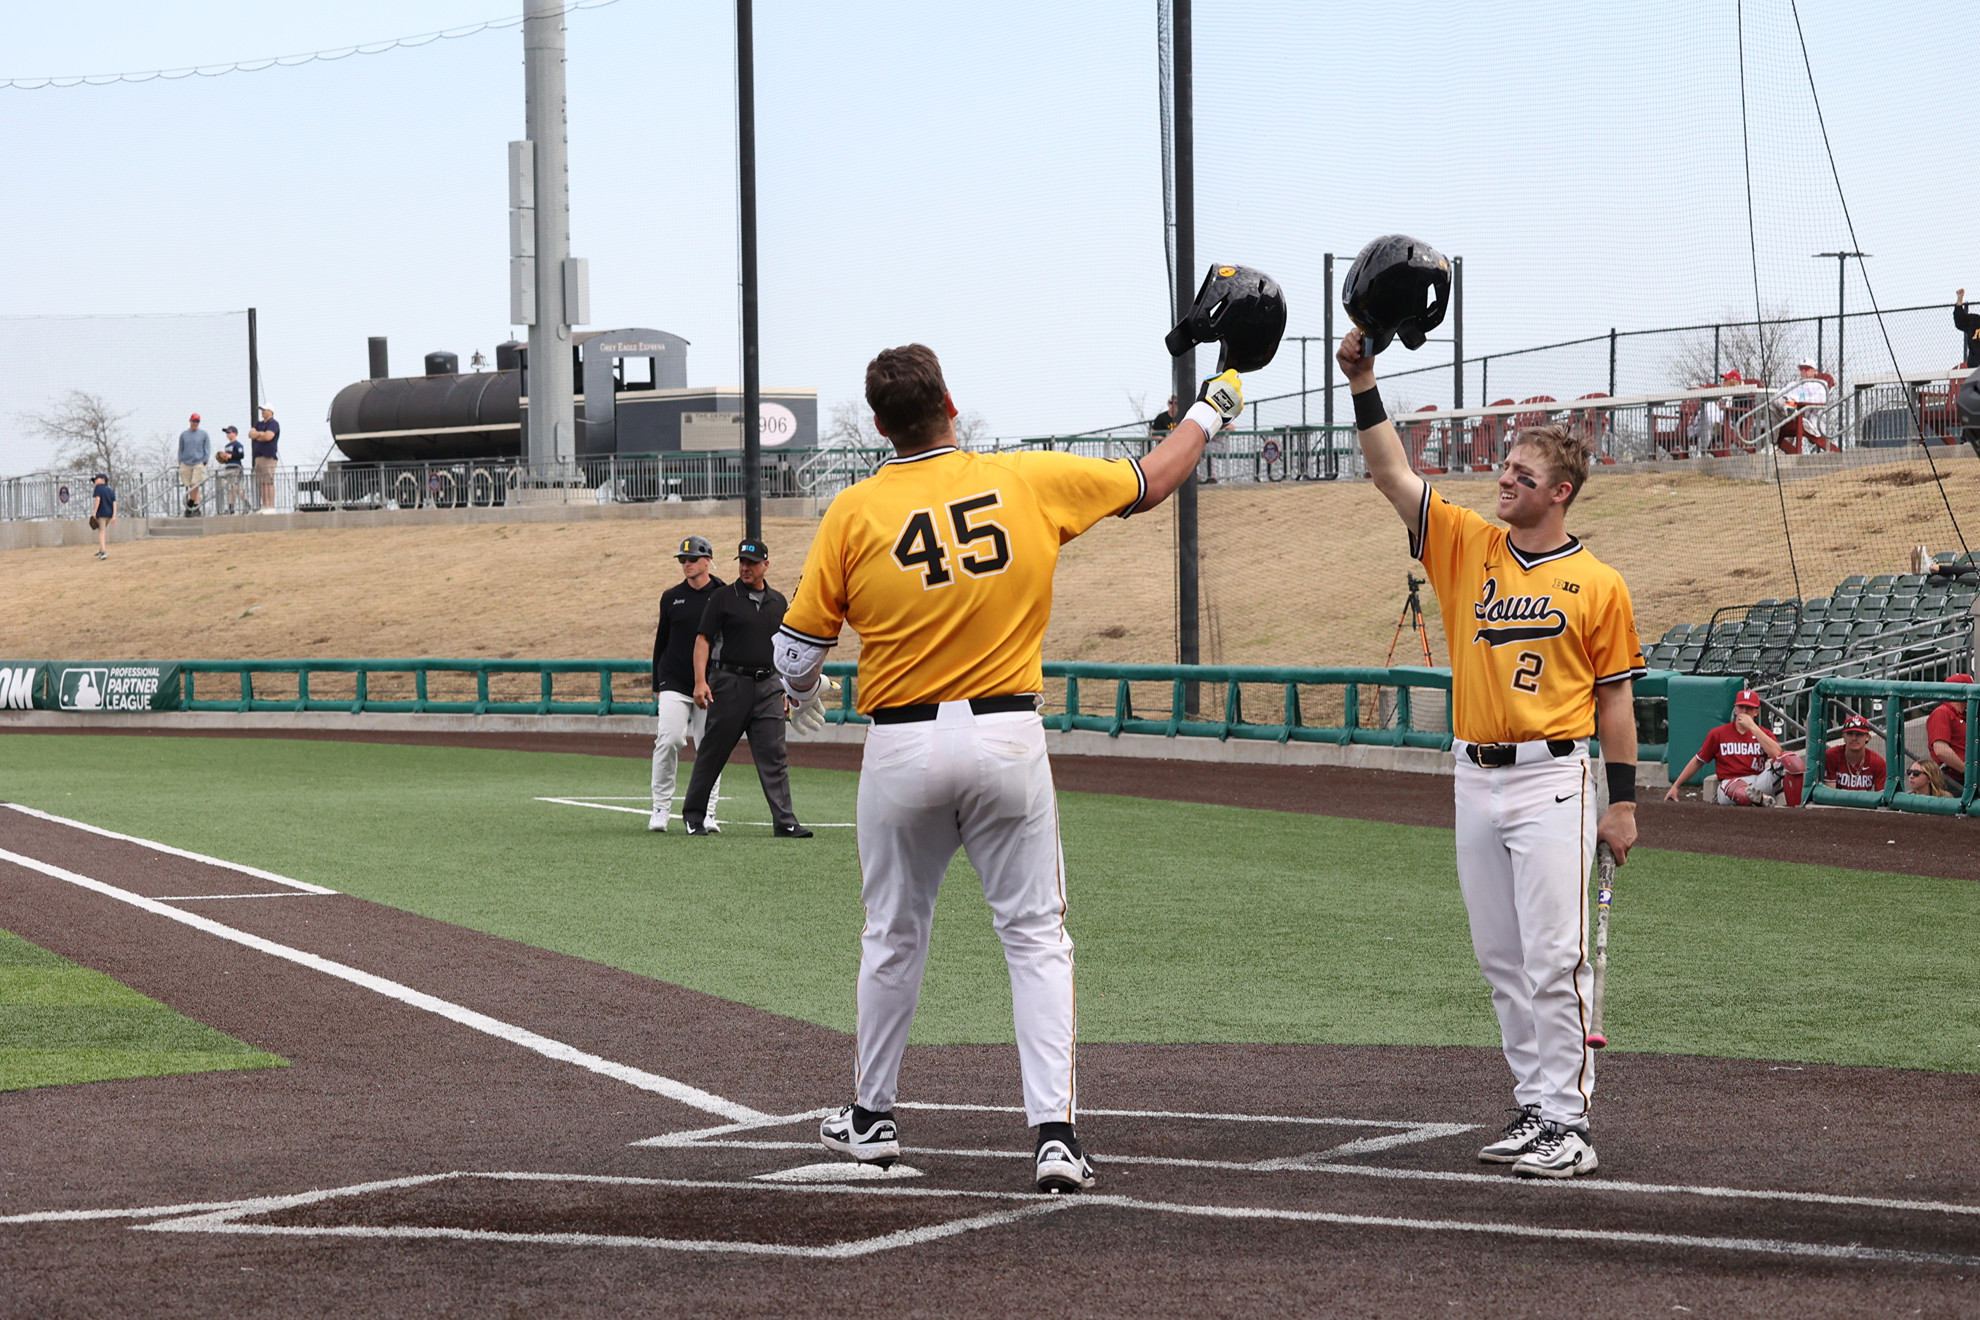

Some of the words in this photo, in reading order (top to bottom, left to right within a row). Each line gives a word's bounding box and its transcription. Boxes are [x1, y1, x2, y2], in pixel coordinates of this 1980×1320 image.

[890, 488, 1014, 591] 45
[1475, 577, 1557, 623] Iowa
[110, 667, 160, 677] PROFESSIONAL
[1511, 650, 1544, 695] 2
[107, 678, 158, 693] PARTNER
[106, 694, 152, 710] LEAGUE
[1743, 691, 1751, 699] W
[879, 1130, 895, 1139] NIKE
